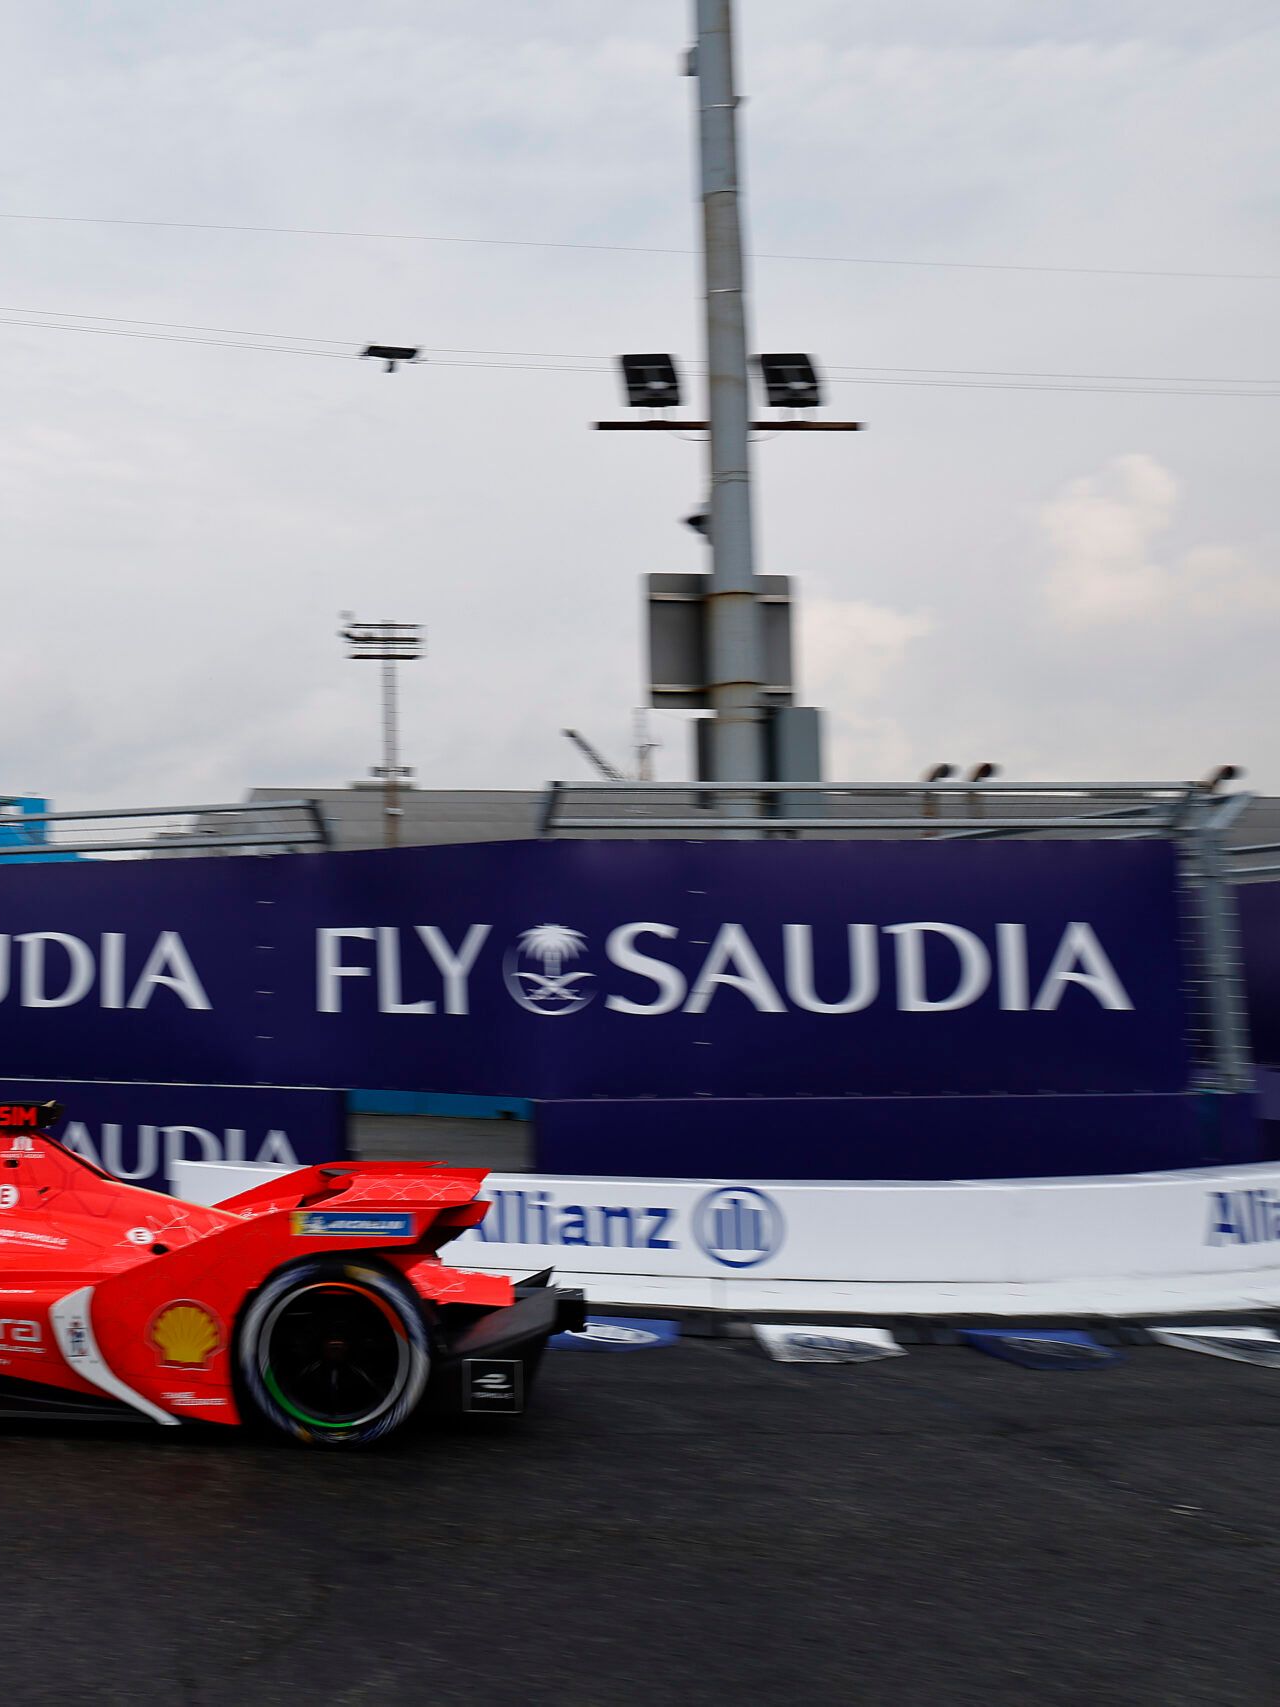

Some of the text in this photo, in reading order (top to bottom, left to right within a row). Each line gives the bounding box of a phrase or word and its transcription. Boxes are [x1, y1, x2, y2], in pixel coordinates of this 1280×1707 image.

[317, 921, 1136, 1016] FLY SAUDIA
[58, 1120, 302, 1196] AUDIA
